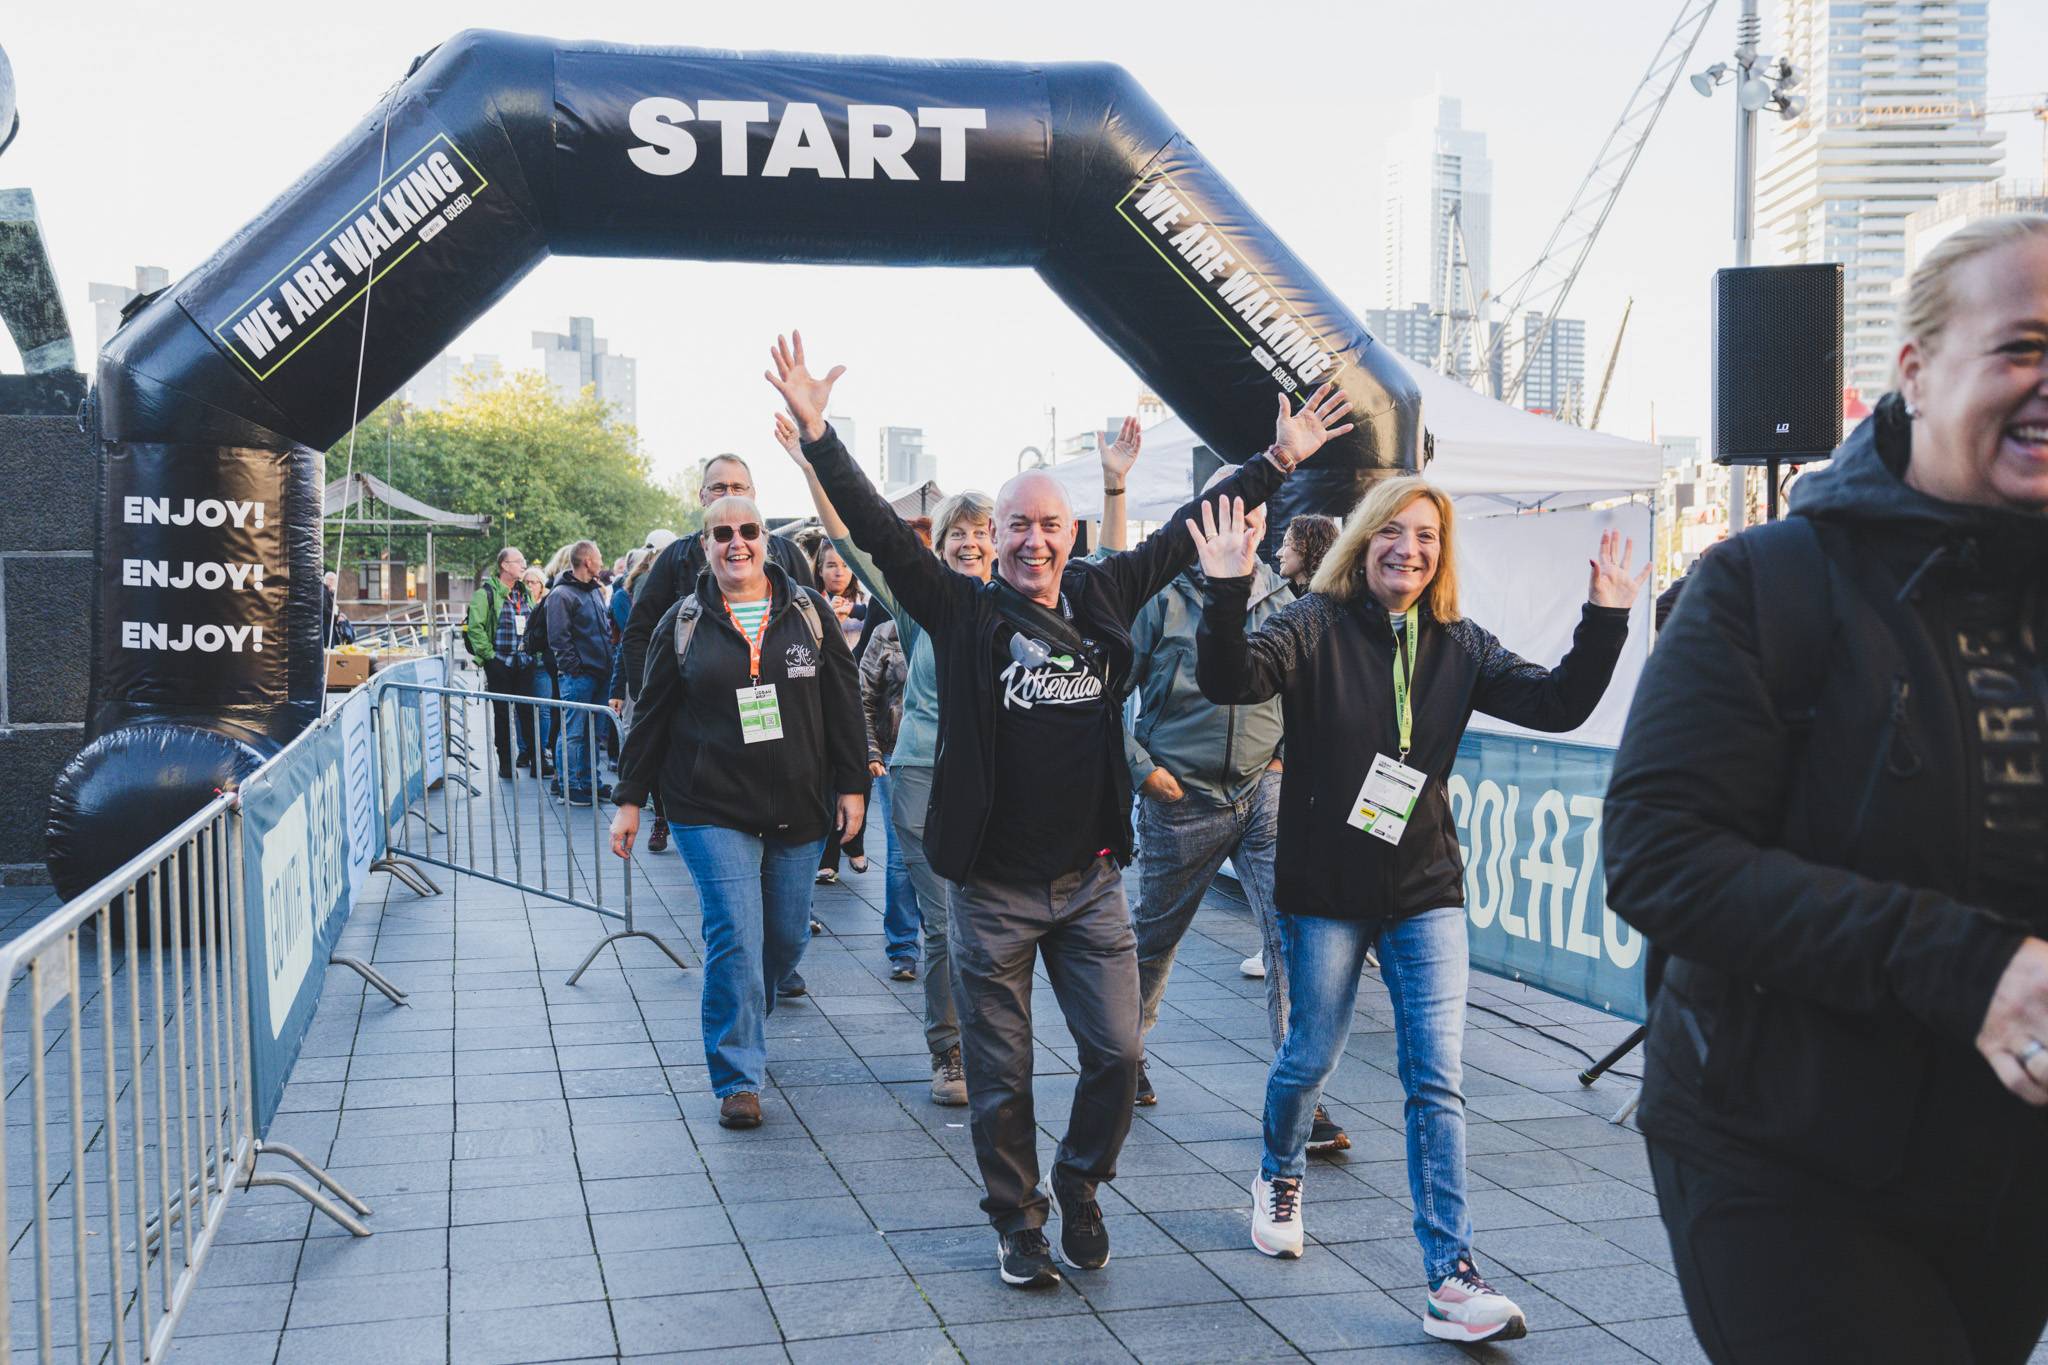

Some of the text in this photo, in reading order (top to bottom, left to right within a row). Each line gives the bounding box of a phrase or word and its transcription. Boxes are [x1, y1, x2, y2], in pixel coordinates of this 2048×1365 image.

[627, 96, 987, 182] START
[443, 193, 472, 221] GOLAZO
[232, 151, 464, 360] WE ARE WALKING
[1134, 181, 1332, 386] WE ARE WALKING
[1271, 366, 1298, 393] GOLAZO
[1775, 423, 1790, 431] LD
[123, 495, 265, 530] ENJOY!
[122, 558, 264, 592] ENJOY!
[121, 621, 264, 653] ENJOY!
